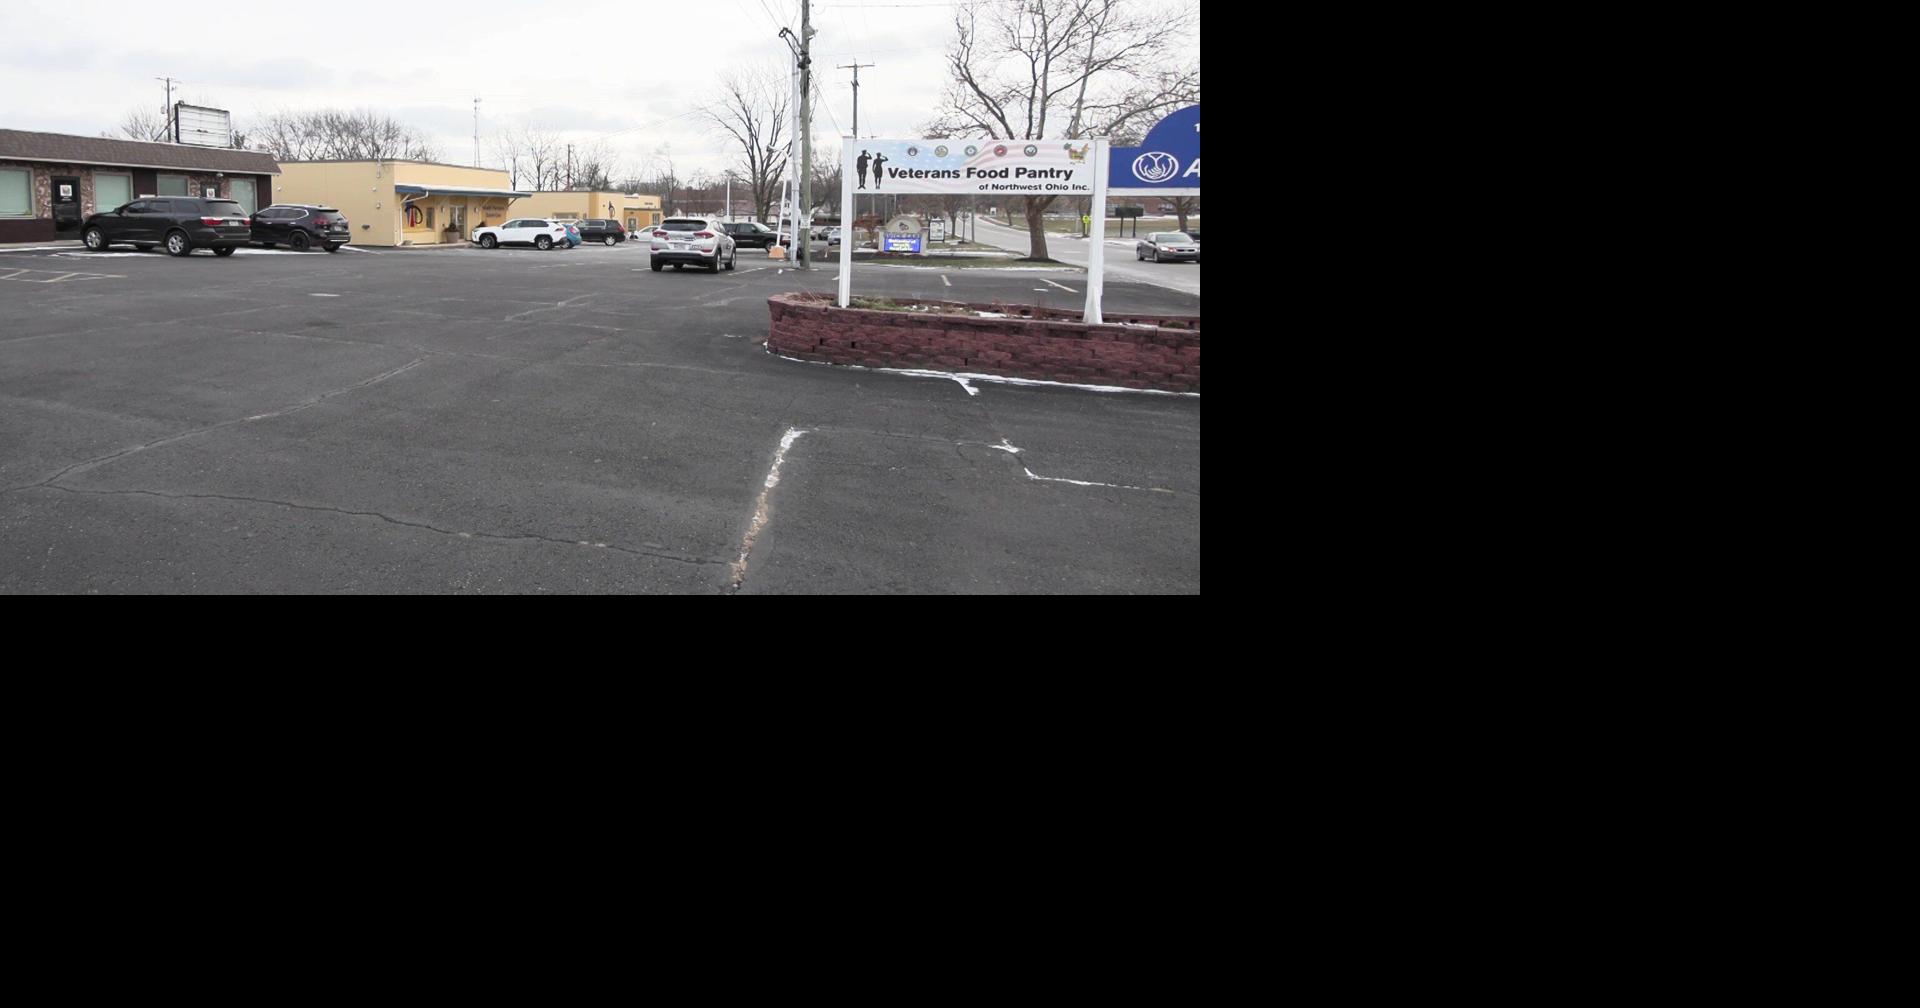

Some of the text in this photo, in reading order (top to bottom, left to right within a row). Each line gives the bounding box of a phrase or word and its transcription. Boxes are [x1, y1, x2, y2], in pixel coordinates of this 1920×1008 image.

[887, 167, 1073, 181] Veterans Food Pantry
[978, 183, 1090, 191] of Northwest Ohio Inc.
